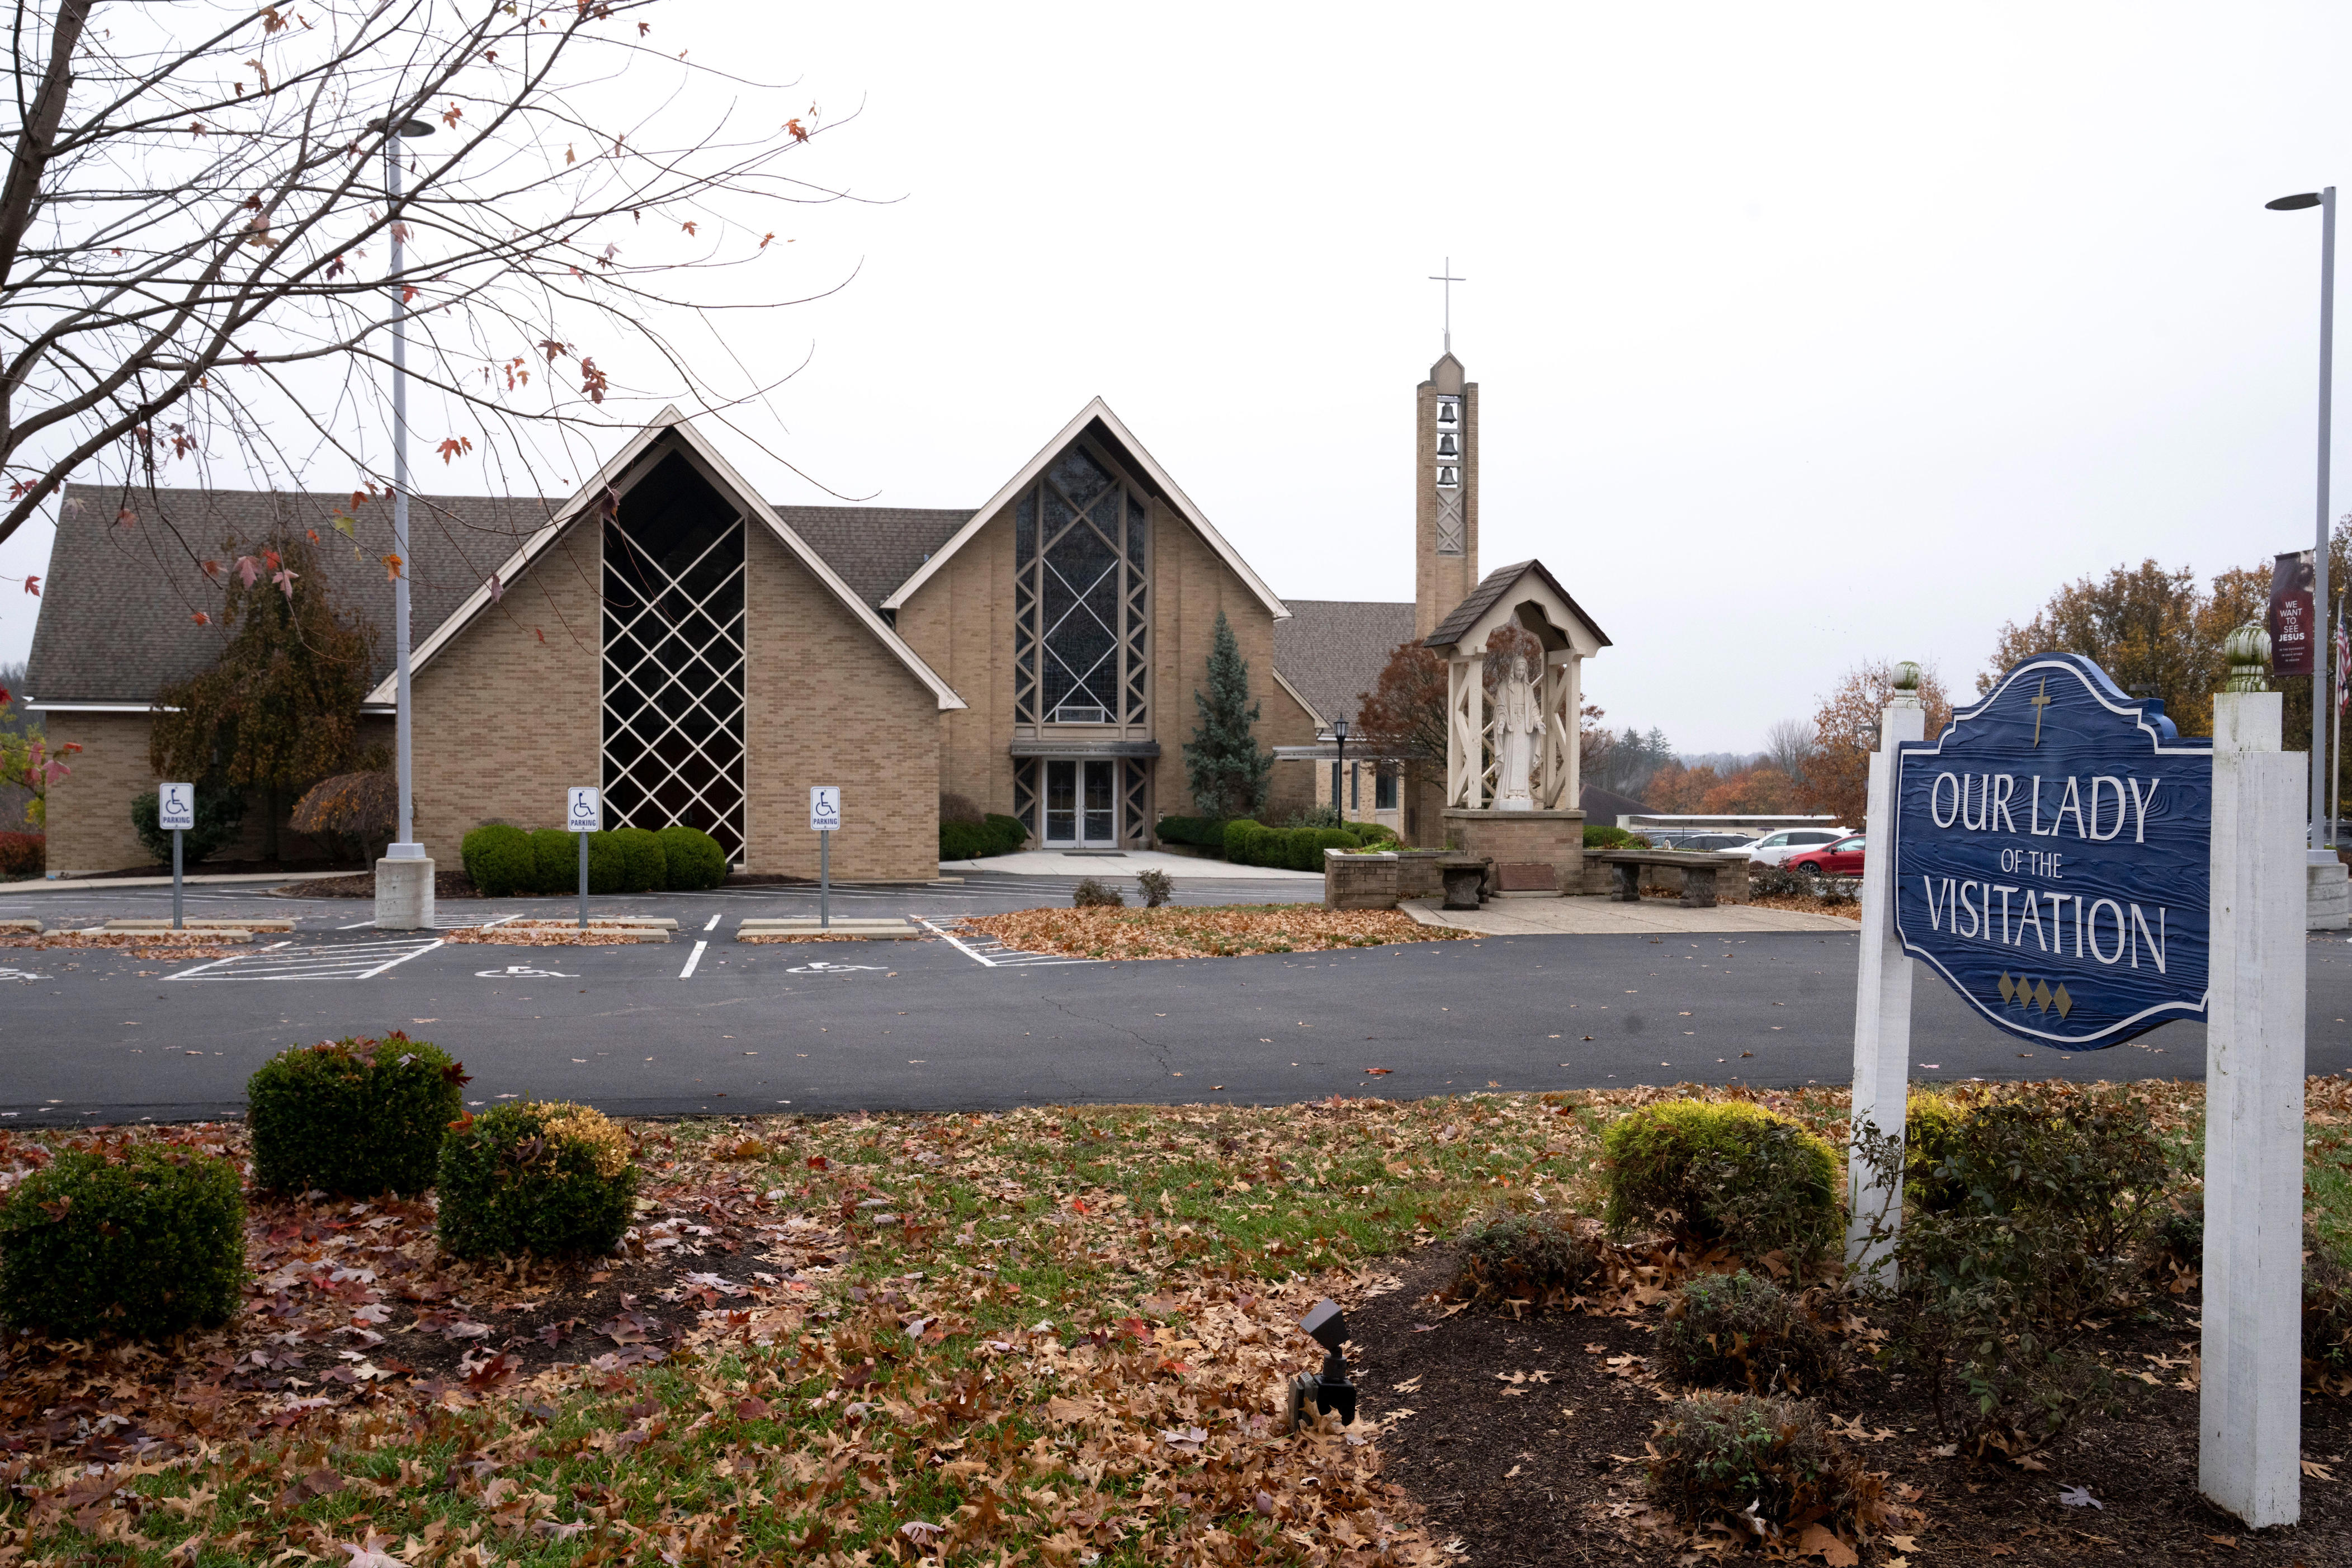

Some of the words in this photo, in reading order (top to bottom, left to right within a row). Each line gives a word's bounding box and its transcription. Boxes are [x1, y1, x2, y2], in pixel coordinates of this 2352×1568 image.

[2280, 608, 2302, 617] WANT
[2279, 632, 2304, 642] JESUS
[2284, 625, 2298, 633] SEE
[1931, 772, 2016, 833] OUR
[2030, 775, 2160, 843] LADY
[2001, 848, 2024, 873] OF
[2028, 851, 2063, 879] THE
[1923, 875, 2166, 974] VISITATION
